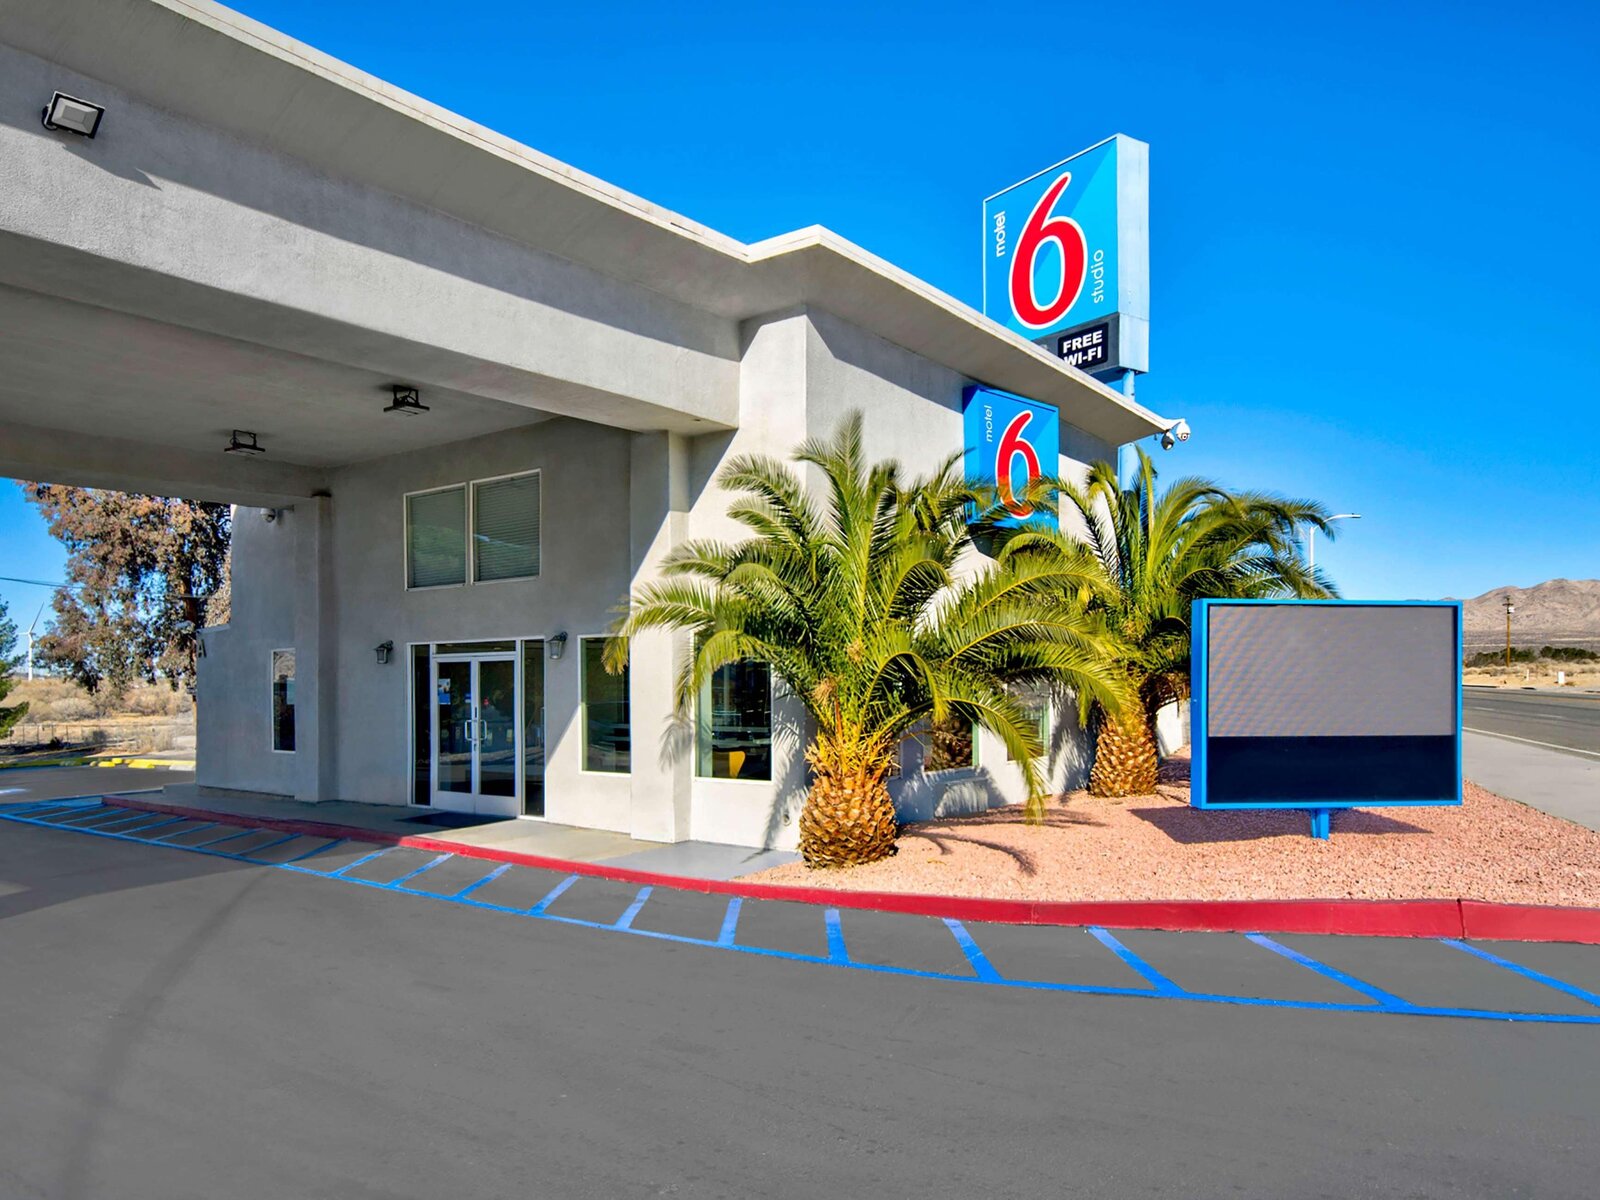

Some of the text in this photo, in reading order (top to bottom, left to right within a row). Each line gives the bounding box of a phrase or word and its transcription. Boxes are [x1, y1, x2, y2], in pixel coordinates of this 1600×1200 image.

[994, 211, 1006, 257] motel
[1008, 171, 1088, 329] 6
[1090, 249, 1104, 304] studio
[1062, 330, 1103, 354] FREE
[1063, 346, 1102, 366] WI-FI
[984, 405, 993, 442] motel
[995, 410, 1041, 519] 6
